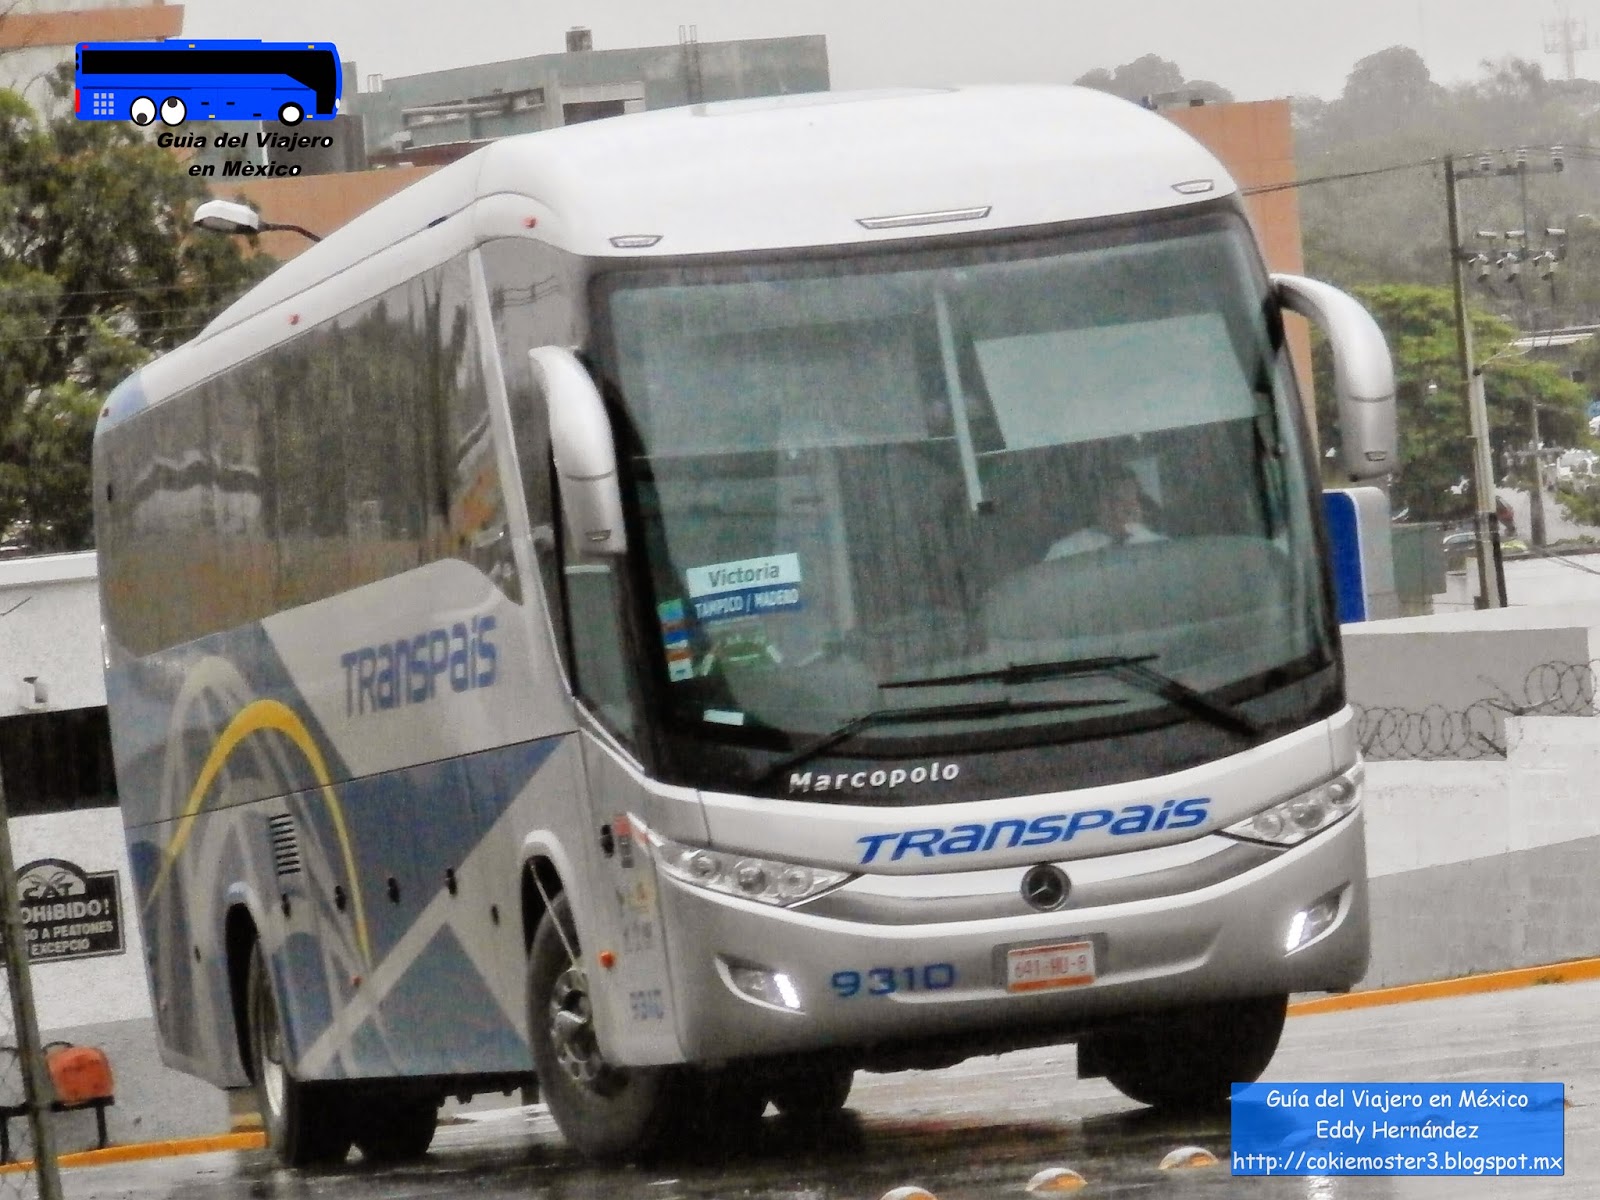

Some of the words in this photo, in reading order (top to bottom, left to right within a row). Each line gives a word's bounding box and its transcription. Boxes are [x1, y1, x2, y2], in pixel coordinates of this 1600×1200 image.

[709, 563, 780, 588] Victoria
[789, 761, 960, 793] Marcopolo
[20, 899, 110, 924] OHIBIDO!
[831, 963, 954, 998] 9310
